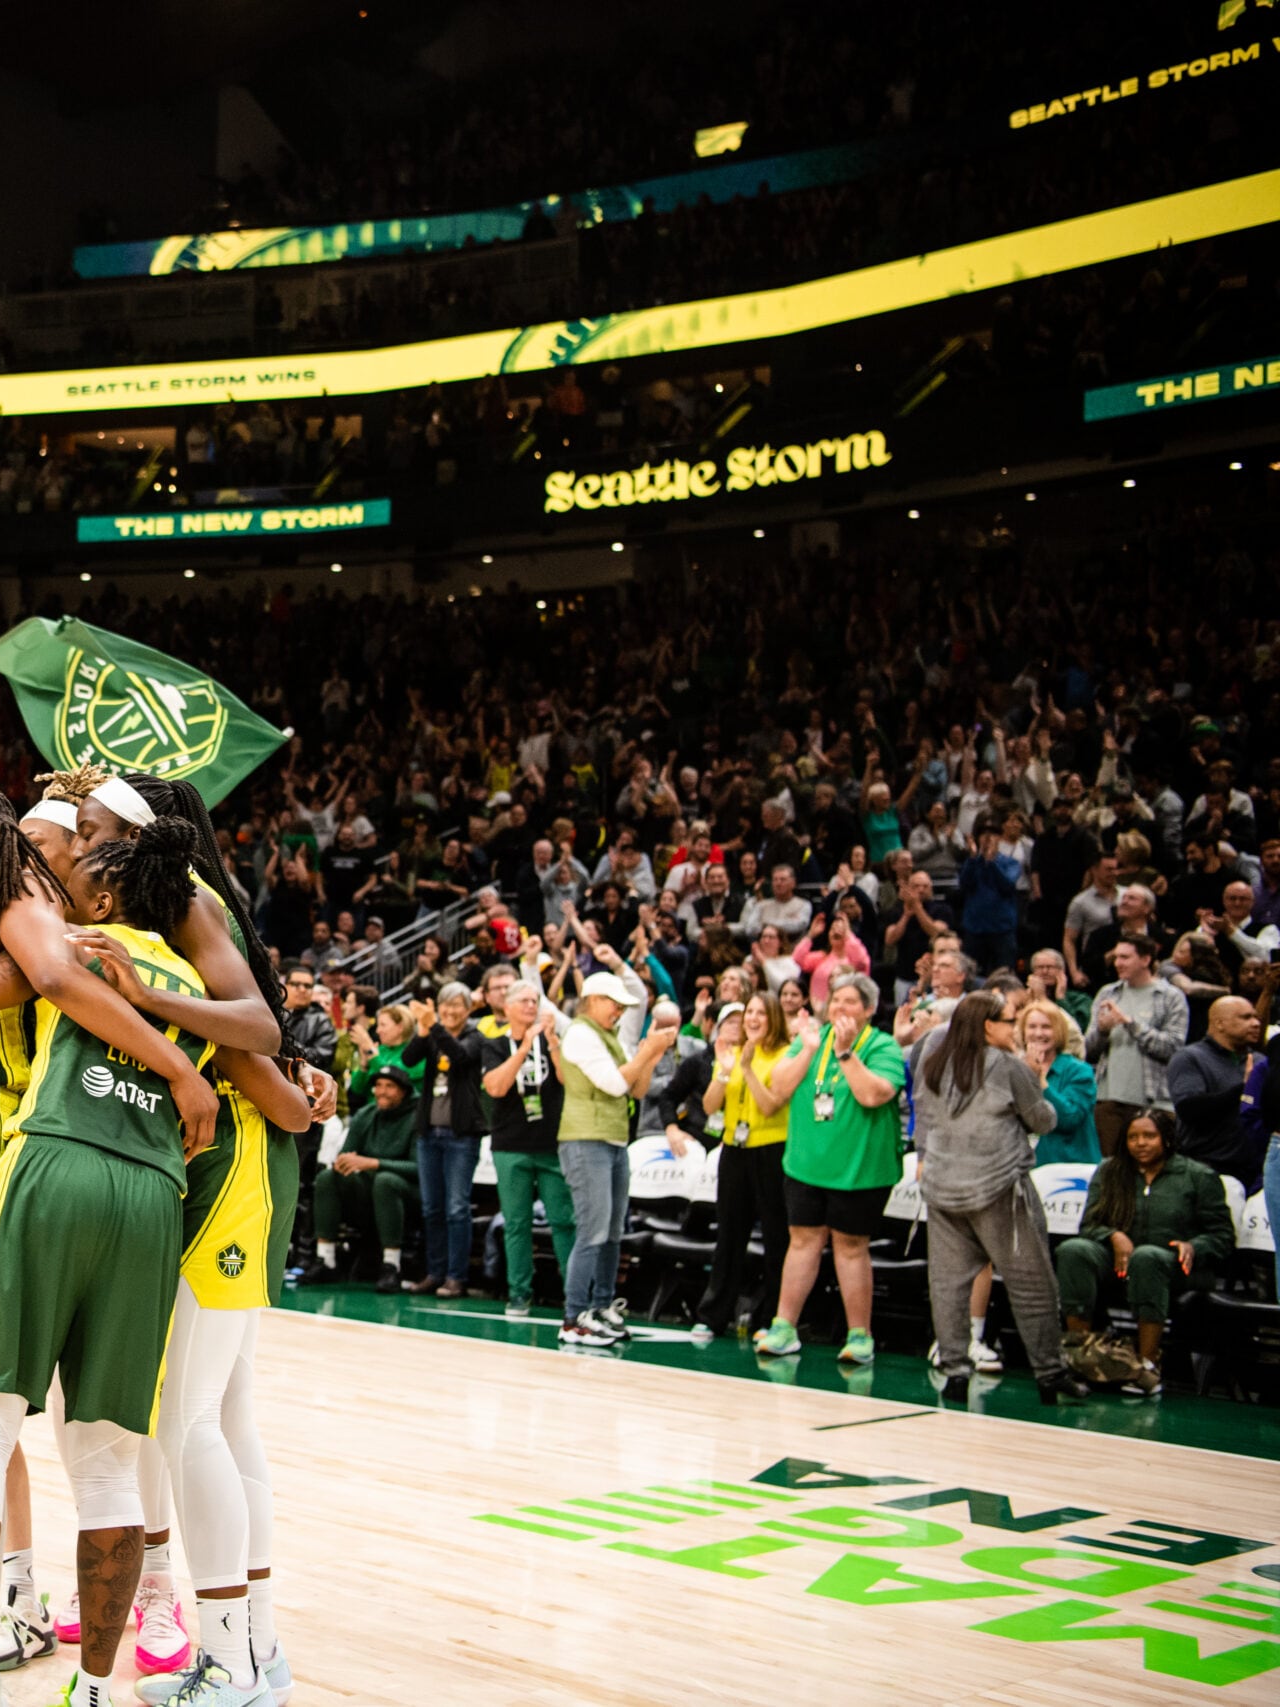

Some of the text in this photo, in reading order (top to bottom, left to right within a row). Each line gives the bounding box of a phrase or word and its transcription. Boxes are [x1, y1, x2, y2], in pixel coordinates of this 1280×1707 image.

[1009, 43, 1261, 129] SEATTLE STORM
[67, 370, 316, 396] SEATTLE STORM WINS
[1136, 372, 1220, 407] THE
[544, 430, 892, 513] Seattle Storm
[115, 505, 364, 536] THE NEW STORM
[114, 1080, 163, 1114] AT&T
